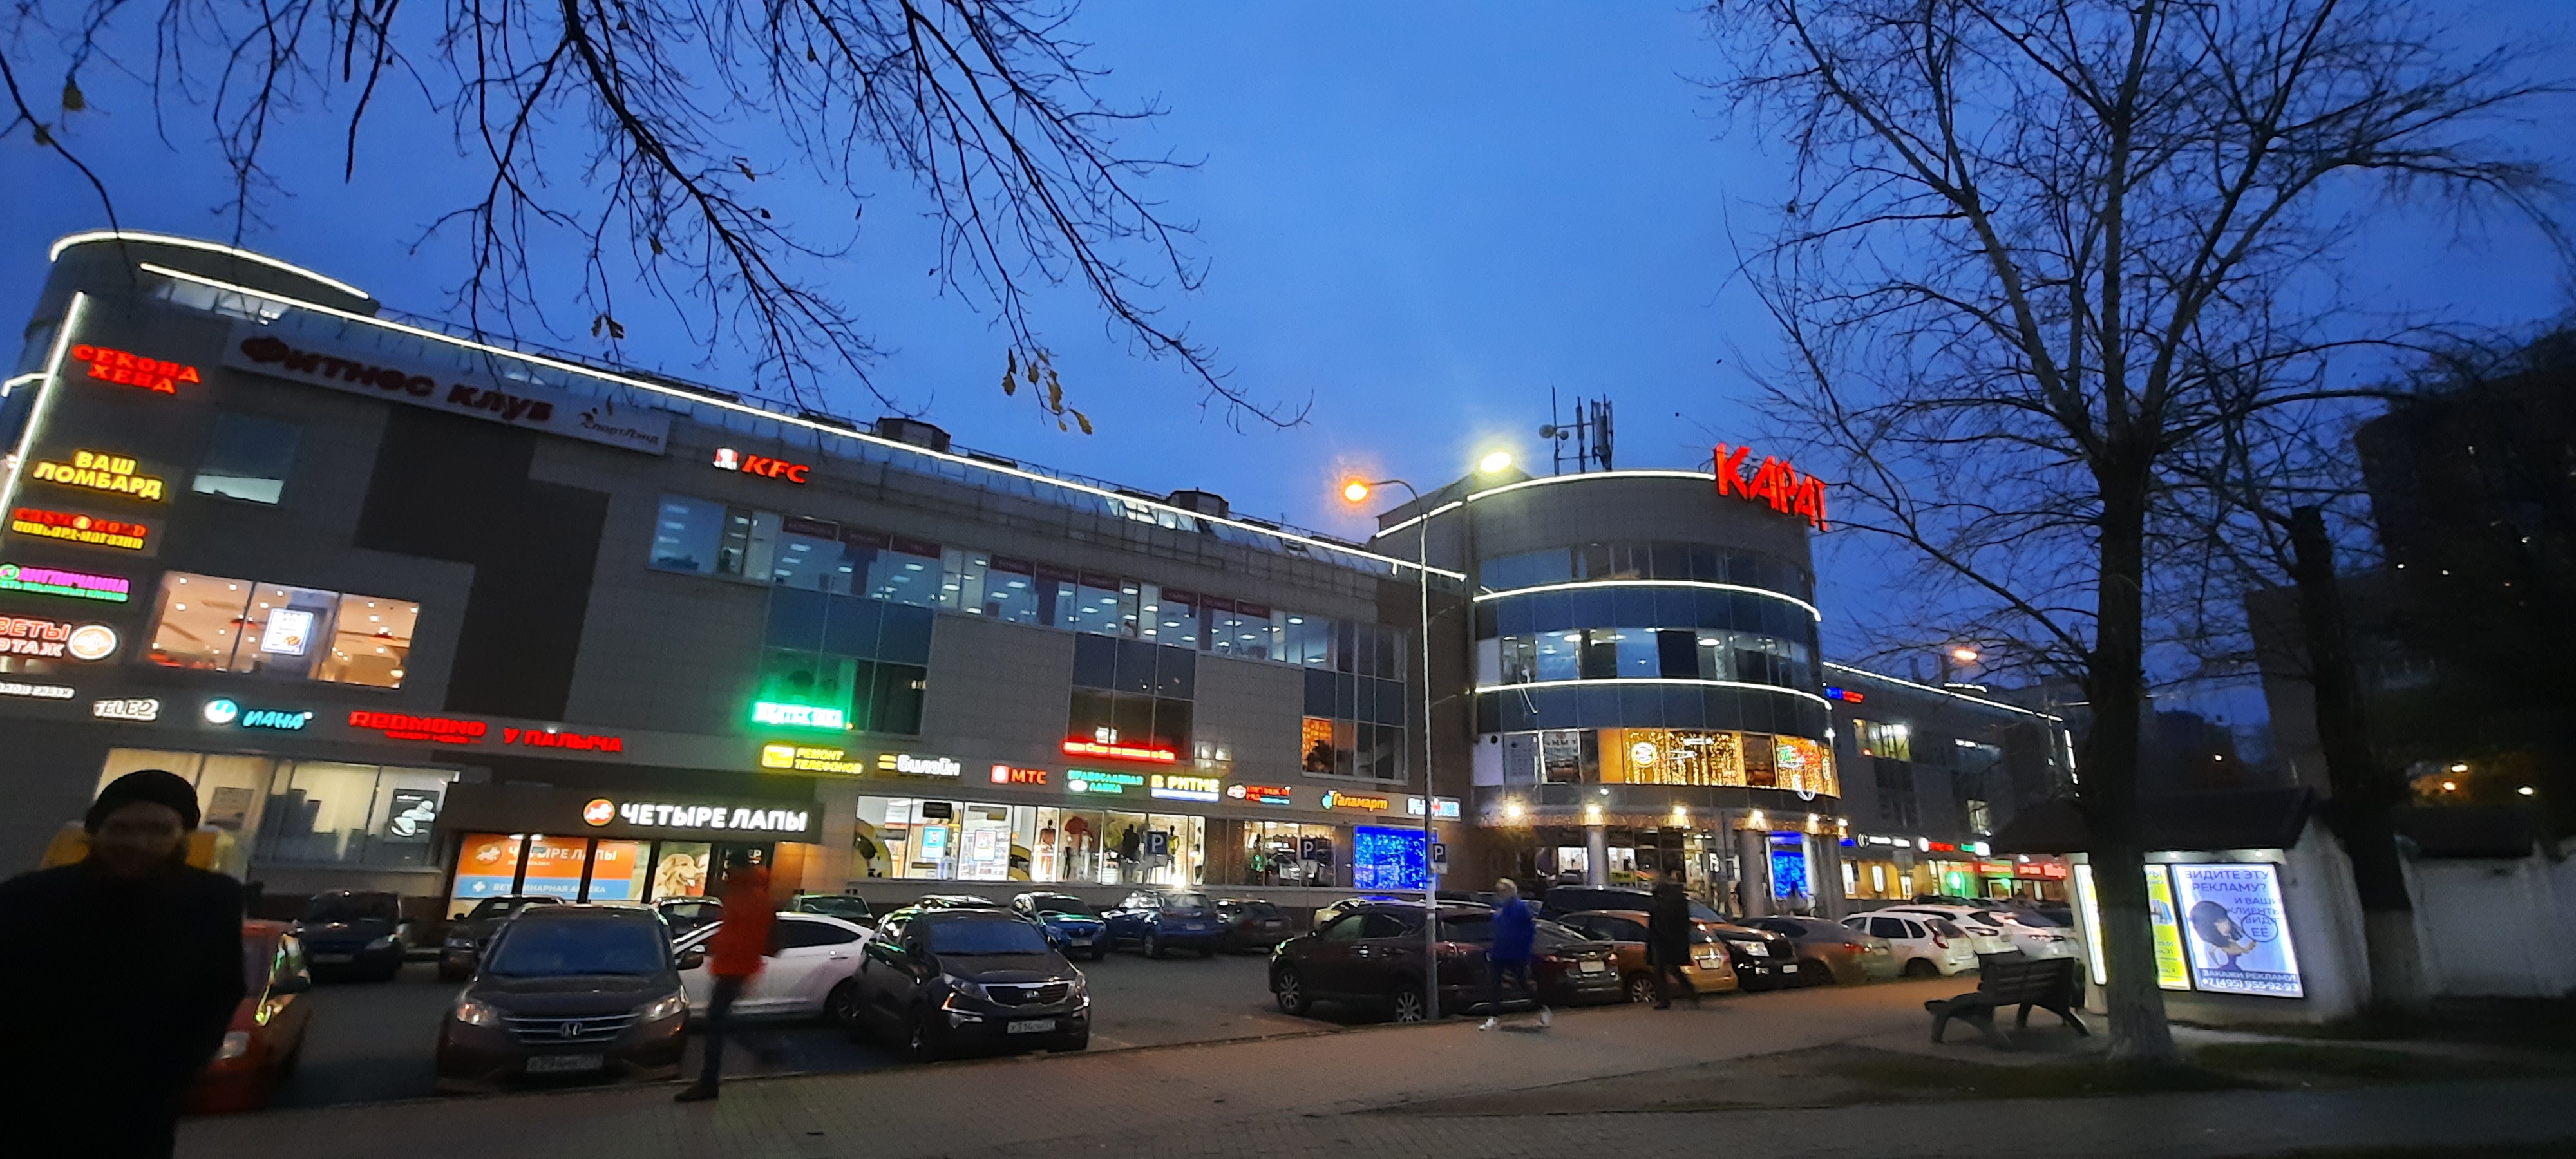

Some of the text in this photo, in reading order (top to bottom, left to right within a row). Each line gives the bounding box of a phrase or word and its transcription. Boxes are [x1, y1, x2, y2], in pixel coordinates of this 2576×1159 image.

[75, 451, 136, 475] ВАШ
[741, 455, 810, 484] KFC
[33, 462, 162, 500] ЛОМБАРД
[1714, 442, 1828, 531] КАРАТ
[93, 699, 159, 721] TELE2
[796, 748, 844, 760] РЕМОНТ
[795, 759, 864, 774] ТЕЛЕФОНОВ
[1011, 769, 1046, 784] МТС
[1151, 775, 1220, 793] В РИТМЕ
[1333, 793, 1388, 811] Галамарт
[621, 804, 808, 831] ЧЕТЫРЕ ЛАПЫ
[571, 849, 617, 861] ЛПЫ
[2184, 871, 2269, 880] ВИДИТЕ ЭТУ
[2192, 883, 2266, 892] РЕКЛАМУ?
[2251, 926, 2269, 938] ЕЁ
[2203, 970, 2297, 982] ЗАКАЖИ РЕКЛАМУ!
[2216, 978, 2244, 988] (495)
